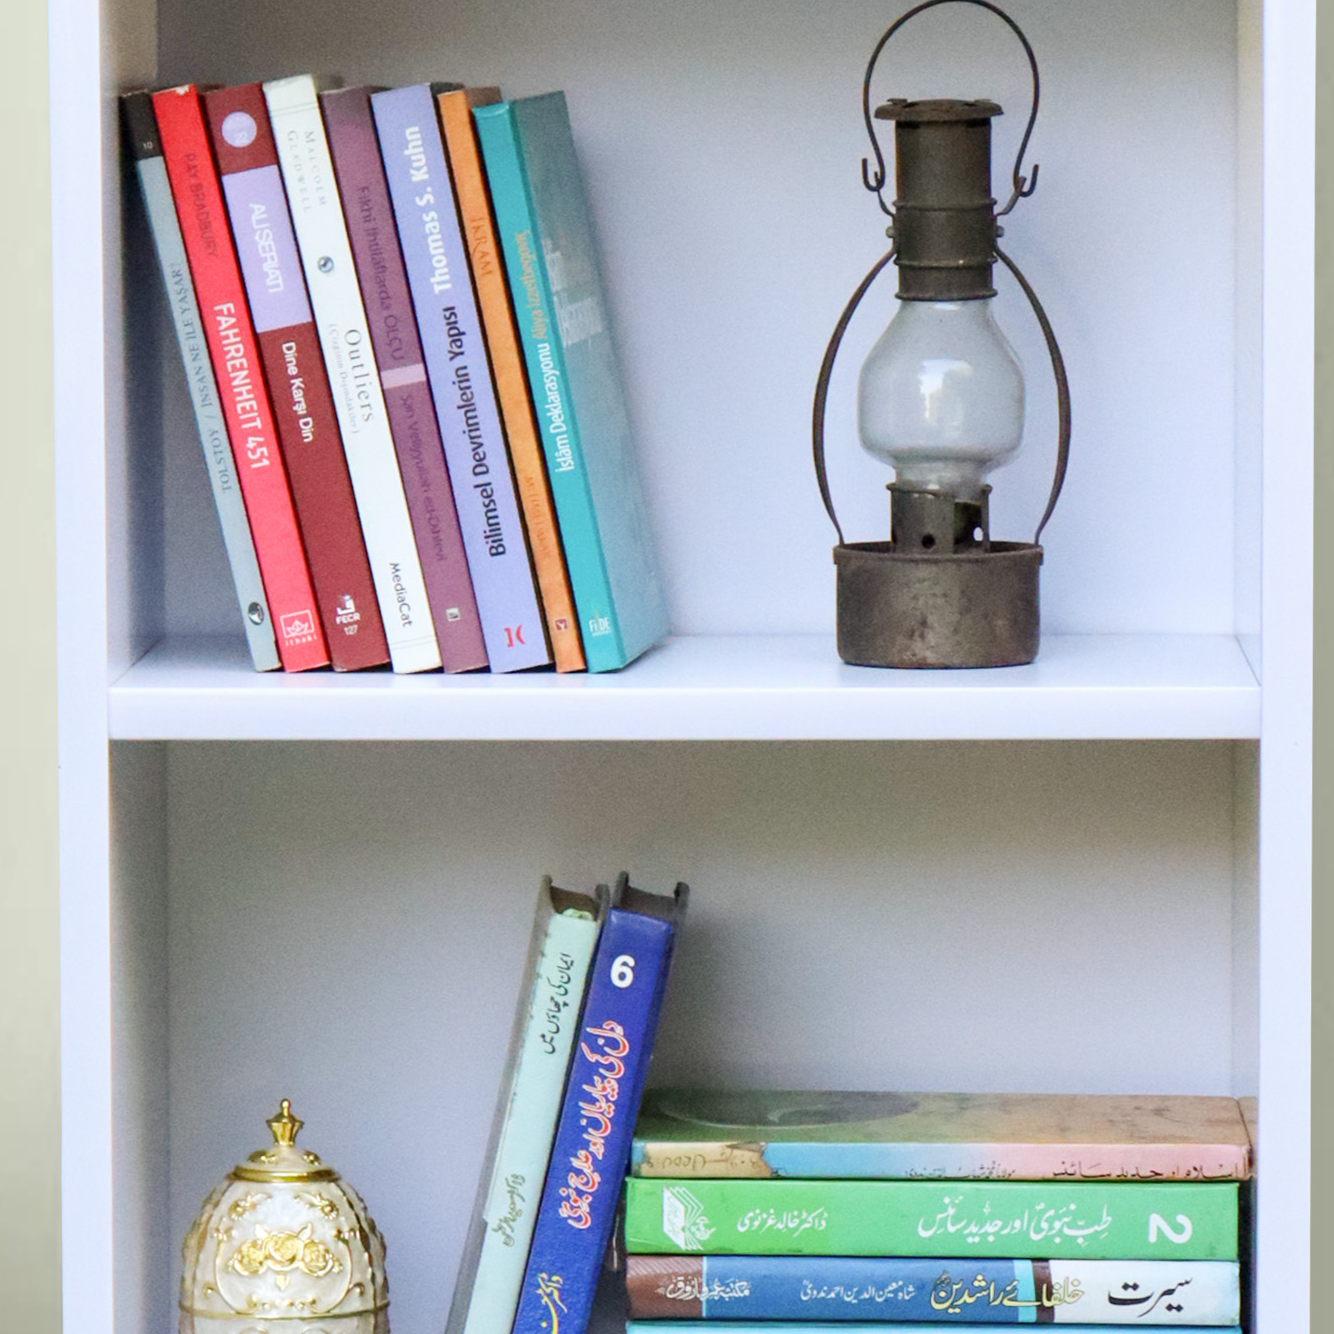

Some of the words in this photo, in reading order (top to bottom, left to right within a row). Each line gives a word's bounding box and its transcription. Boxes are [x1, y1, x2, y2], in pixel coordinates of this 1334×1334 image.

[180, 150, 202, 181] RAY
[284, 127, 316, 214] GLADWELL
[301, 128, 331, 207] MALCOLM
[399, 124, 430, 183] Kuhn
[413, 185, 436, 207] S.
[187, 181, 220, 261] BRADBURY
[416, 209, 454, 295] Thomas
[437, 302, 472, 363] Yapısı
[525, 307, 551, 343] Aliya
[187, 341, 202, 362] NE
[279, 339, 301, 377] Dine
[189, 363, 213, 409] İNSAN
[211, 299, 263, 433] FAHRENHEIT
[242, 432, 271, 470] 451
[342, 326, 381, 423] Outliers
[529, 340, 571, 434] Deklarasyonu
[284, 375, 311, 417] Karşı
[296, 414, 317, 444] Din
[447, 363, 491, 479] Devrimlerin
[206, 424, 234, 494] TOLSTOY
[546, 432, 576, 475] İslâm
[471, 479, 507, 559] Bilimsel
[387, 558, 415, 628] MediaCat
[542, 974, 570, 998] کی
[553, 950, 575, 984] ایمان
[609, 954, 638, 989] 6
[535, 1031, 559, 1056] میں
[573, 1040, 628, 1081] کی
[571, 1072, 621, 1138] بیماریاں
[561, 1145, 606, 1193] علاج
[736, 1208, 778, 1235] غزنوی
[776, 1210, 799, 1233] خالد
[793, 1205, 828, 1237] ڈاکٹر
[917, 1195, 967, 1238] سائنس
[966, 1200, 1005, 1244] جدید
[1000, 1209, 1029, 1236] اور
[1148, 1213, 1193, 1245] 2
[528, 1270, 575, 1312] ڈاکٹر
[825, 1284, 844, 1299] احمد
[843, 1285, 875, 1304] الدین
[874, 1279, 903, 1303] معین
[897, 1283, 916, 1299] شاہ
[1001, 1275, 1085, 1309] خلفائے
[1107, 1276, 1193, 1319] سیرت
